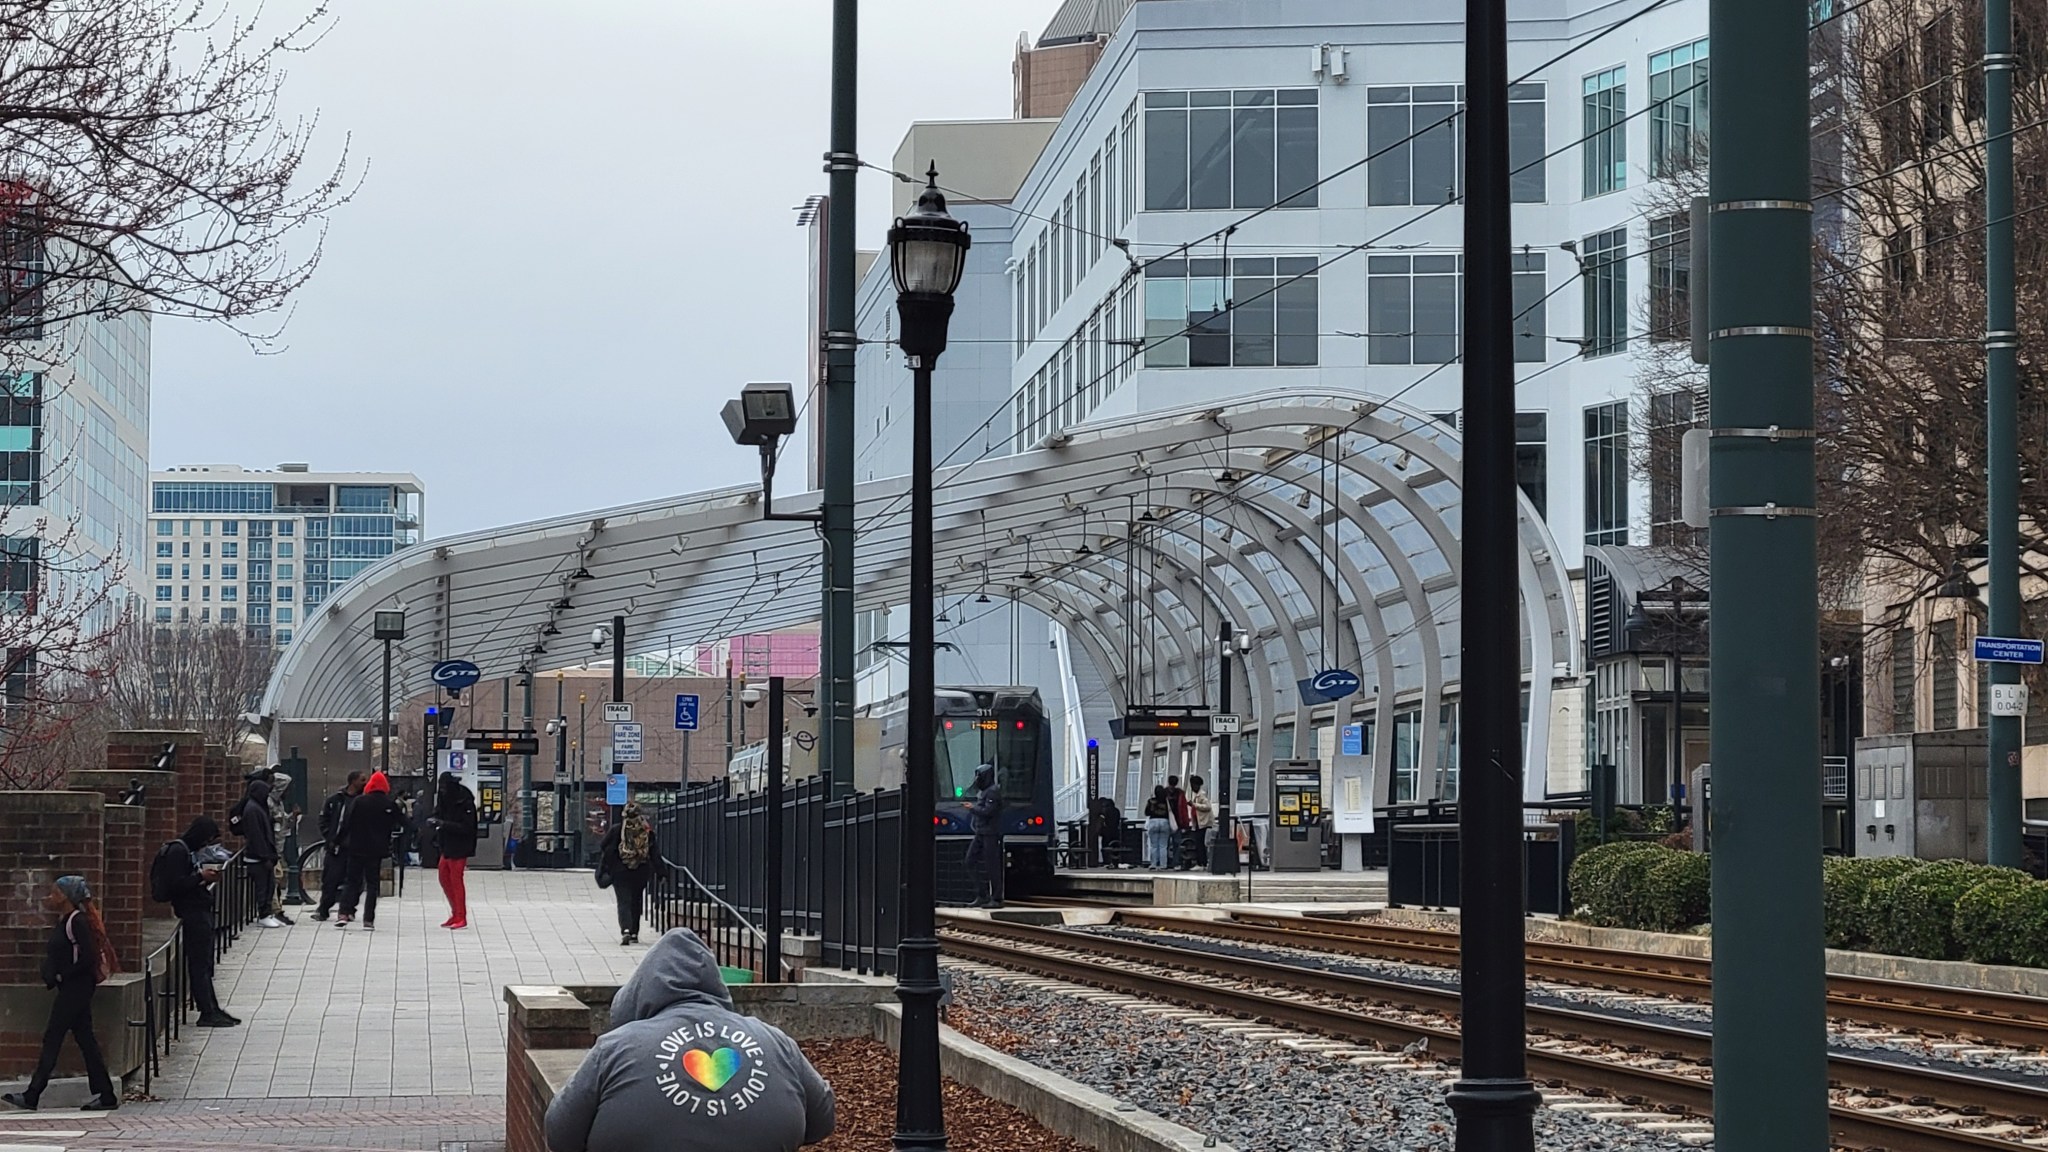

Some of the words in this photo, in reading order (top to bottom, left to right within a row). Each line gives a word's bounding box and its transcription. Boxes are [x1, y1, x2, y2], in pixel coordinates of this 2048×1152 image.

[1977, 641, 2041, 651] TRANSPORTATION
[1993, 650, 2024, 658] CENTER
[976, 708, 992, 717] 311
[427, 725, 435, 782] EMERGENCY
[655, 1027, 694, 1060] LOVE
[695, 1021, 715, 1038] IS
[720, 1025, 764, 1058] LOVE
[656, 1071, 700, 1113] LOVE
[730, 1068, 768, 1110] LOVE
[706, 1099, 727, 1116] IS
